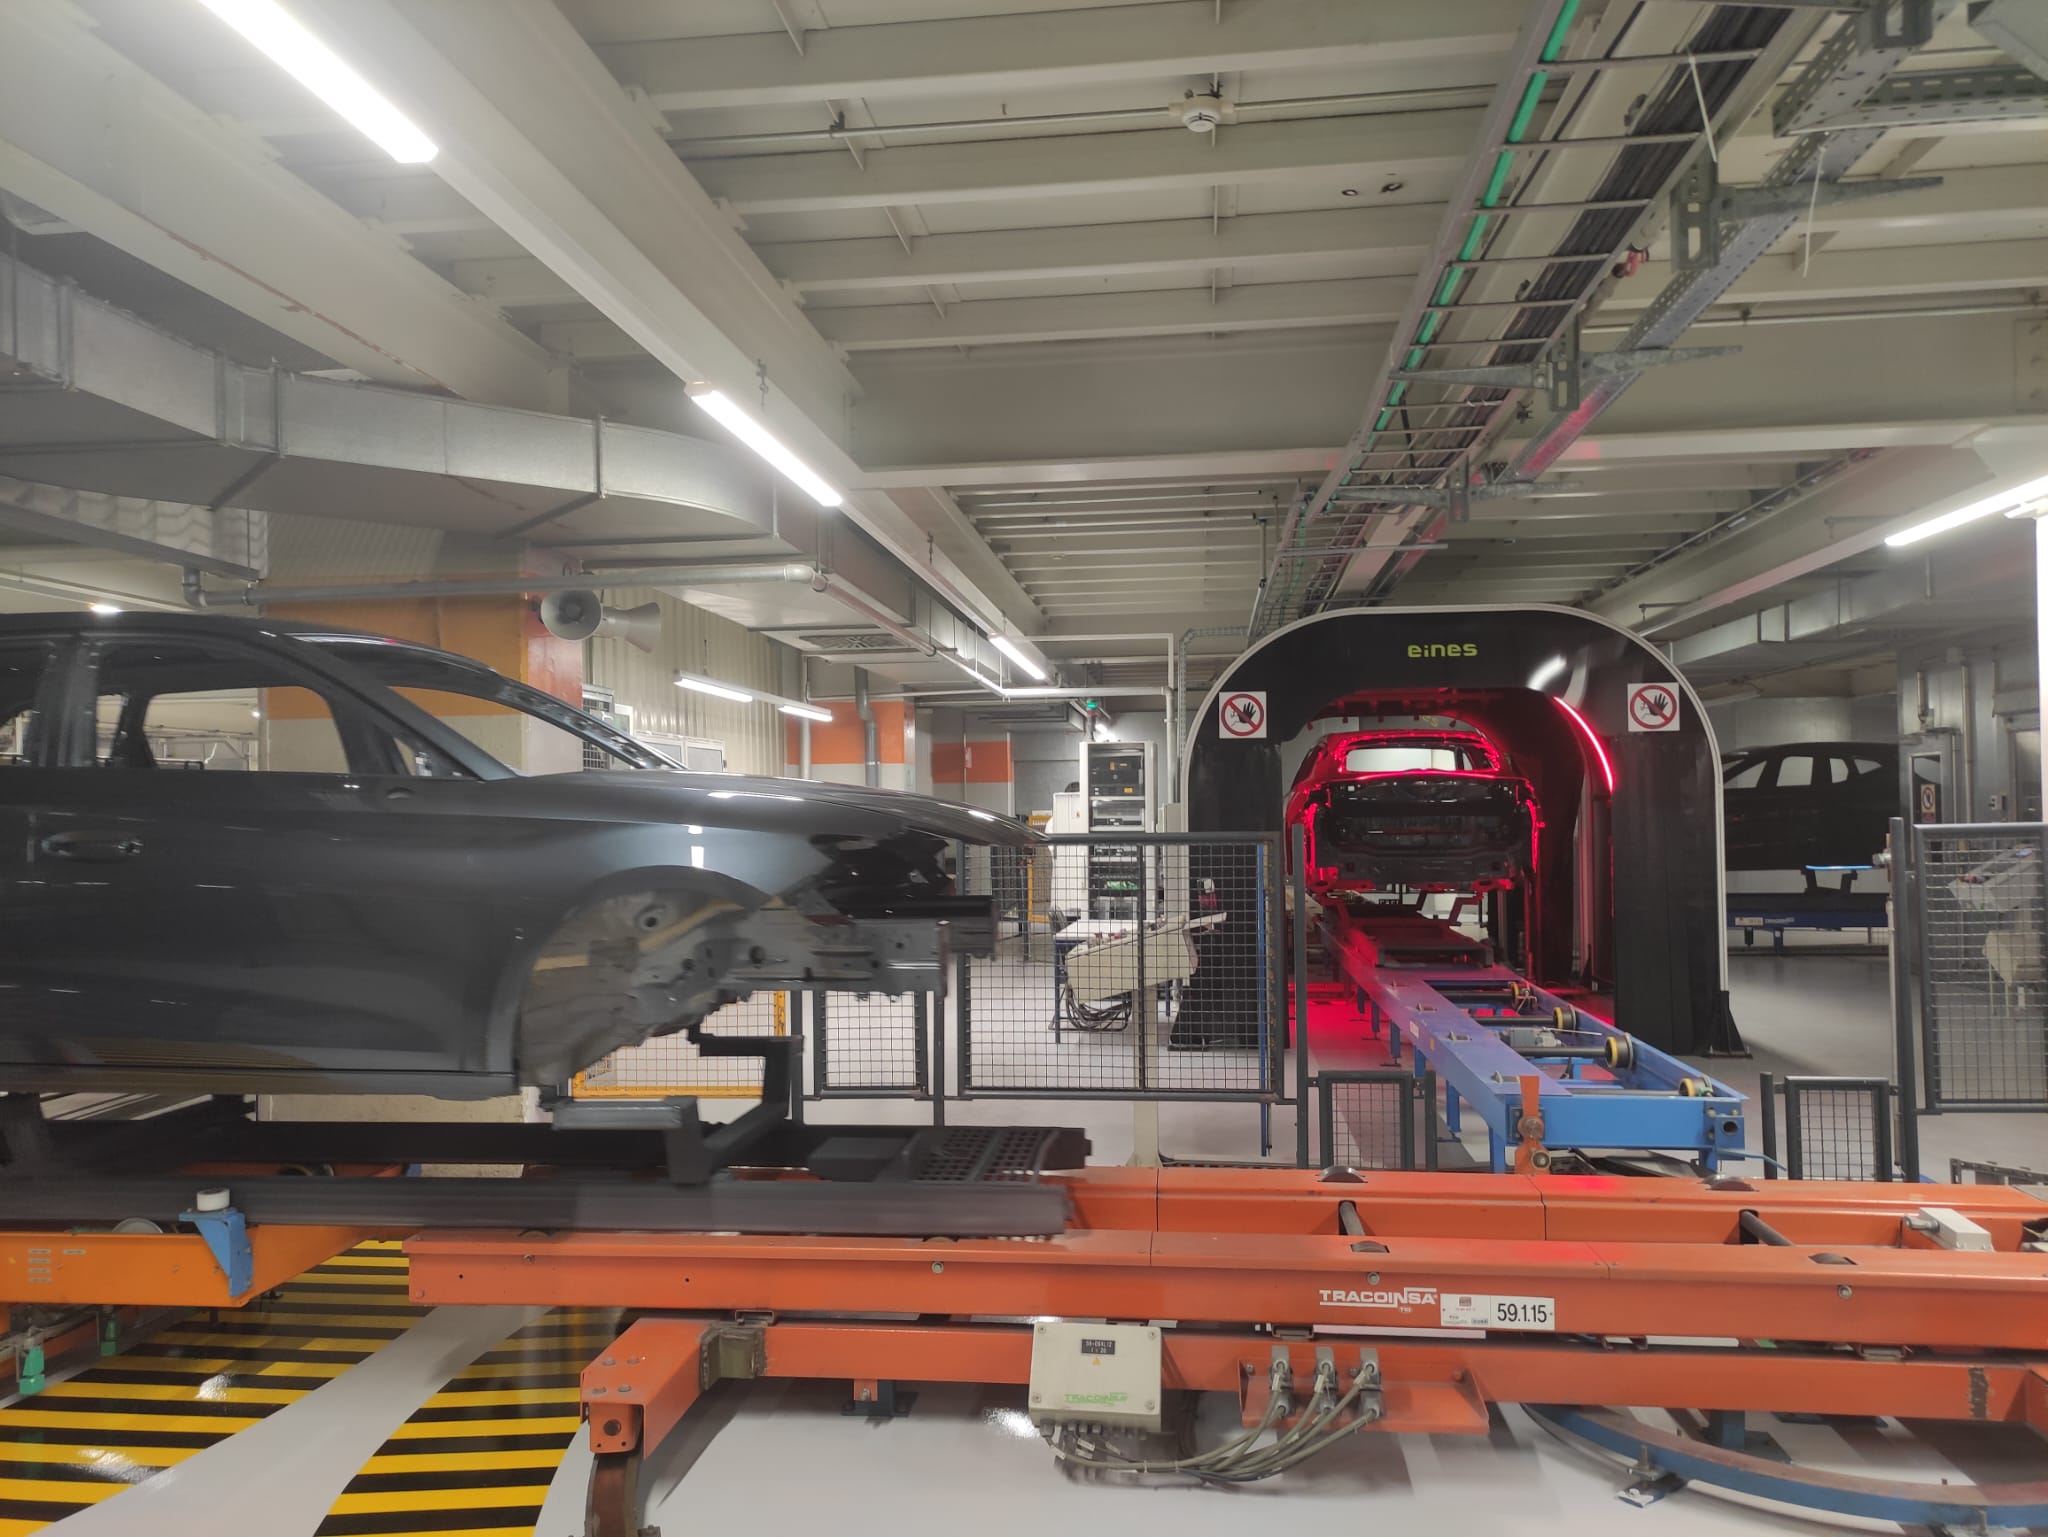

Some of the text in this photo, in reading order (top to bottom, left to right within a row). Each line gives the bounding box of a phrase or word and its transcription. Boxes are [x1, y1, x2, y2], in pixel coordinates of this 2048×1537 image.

[1408, 643, 1478, 658] eines
[1319, 1287, 1437, 1307] TRACOINSA
[1497, 1303, 1547, 1323] 59.1.15
